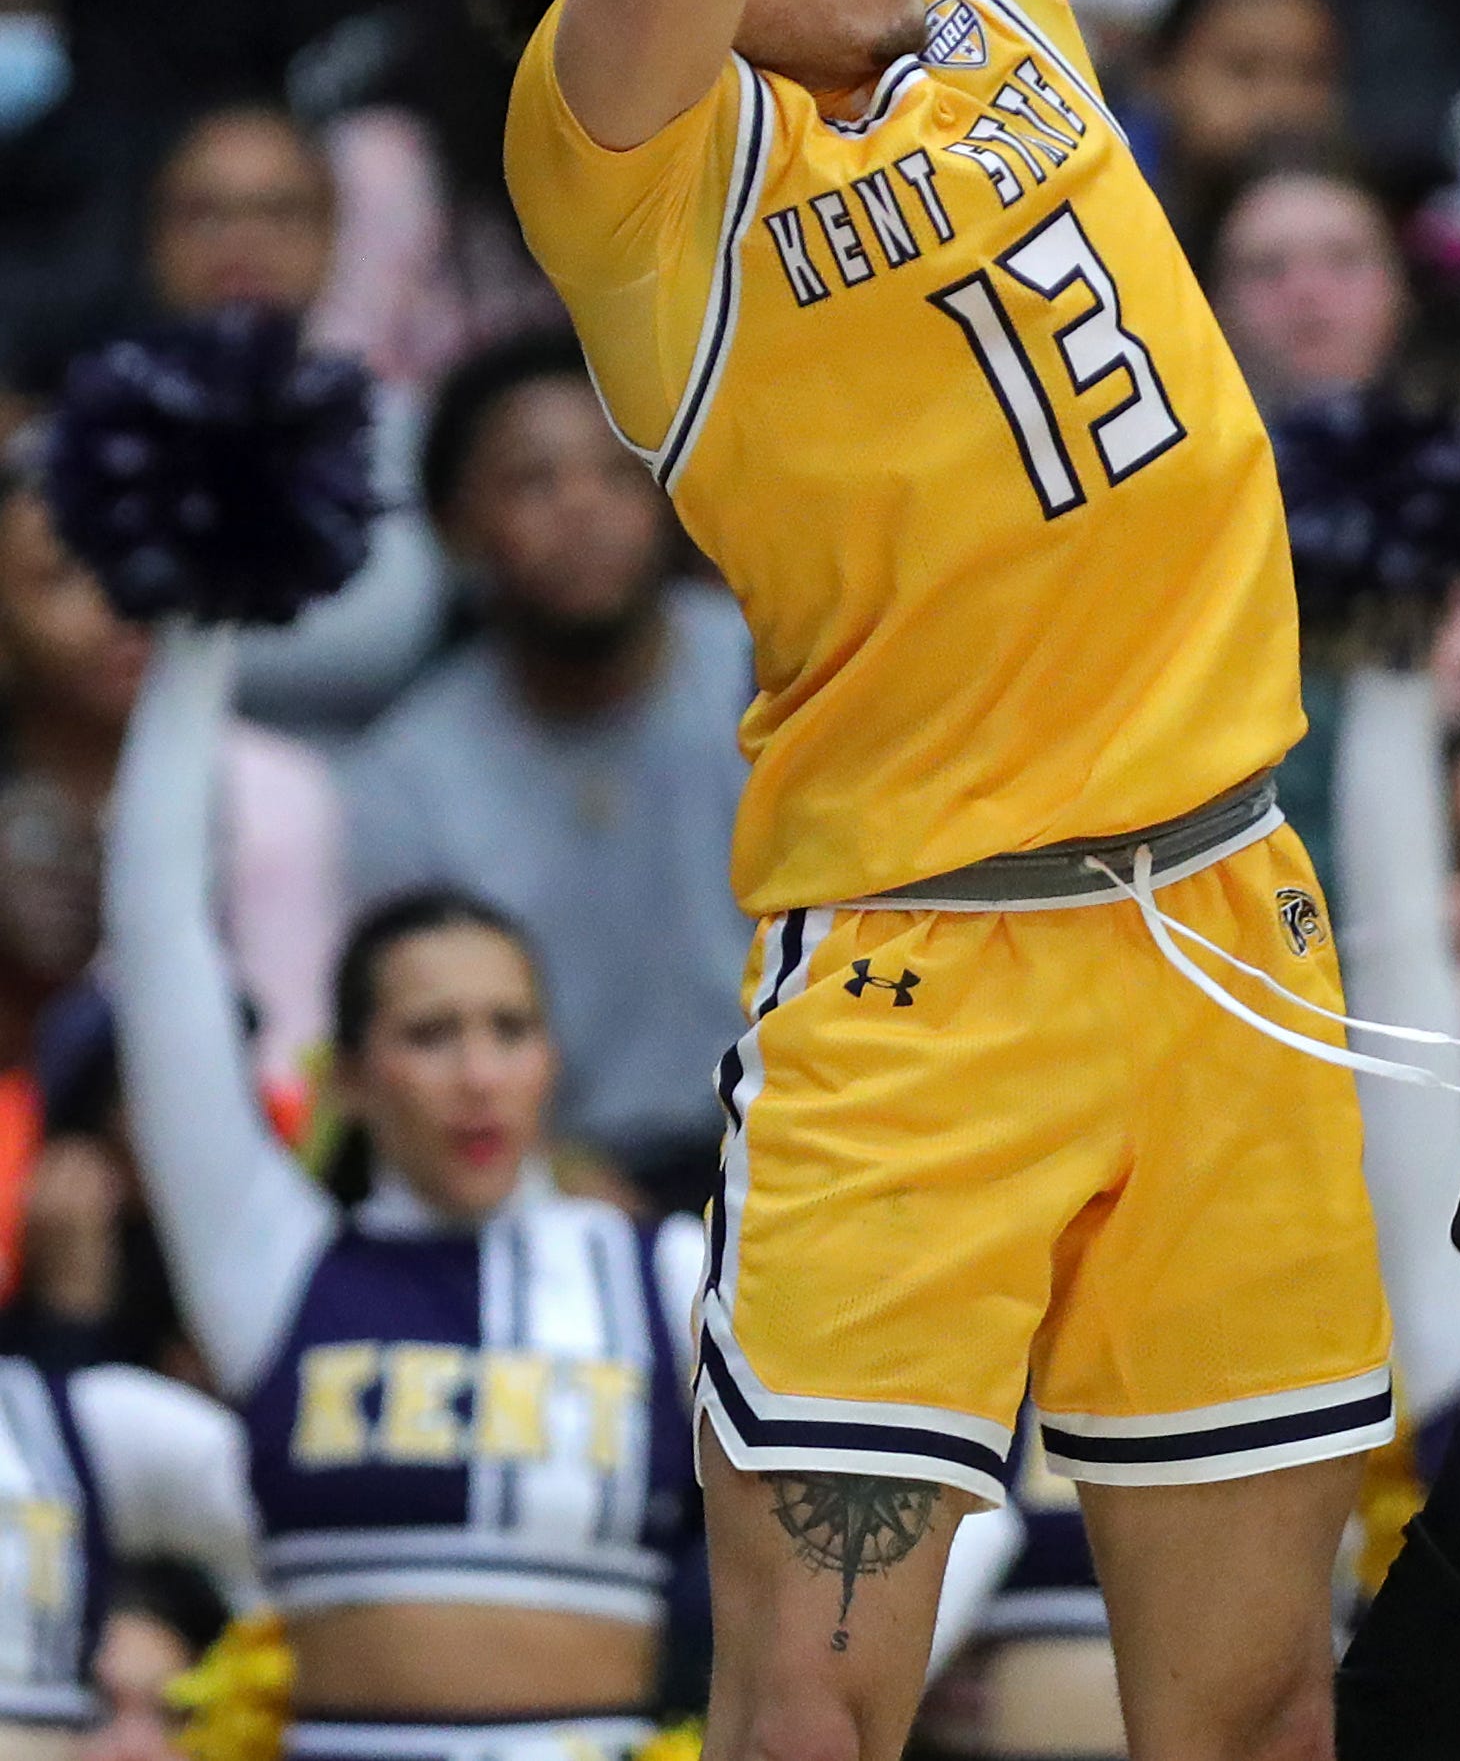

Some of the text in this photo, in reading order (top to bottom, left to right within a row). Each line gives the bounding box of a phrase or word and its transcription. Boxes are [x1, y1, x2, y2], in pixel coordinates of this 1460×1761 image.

[763, 149, 955, 308] KENT
[926, 199, 1187, 521] 13
[288, 1339, 642, 1476] KENT
